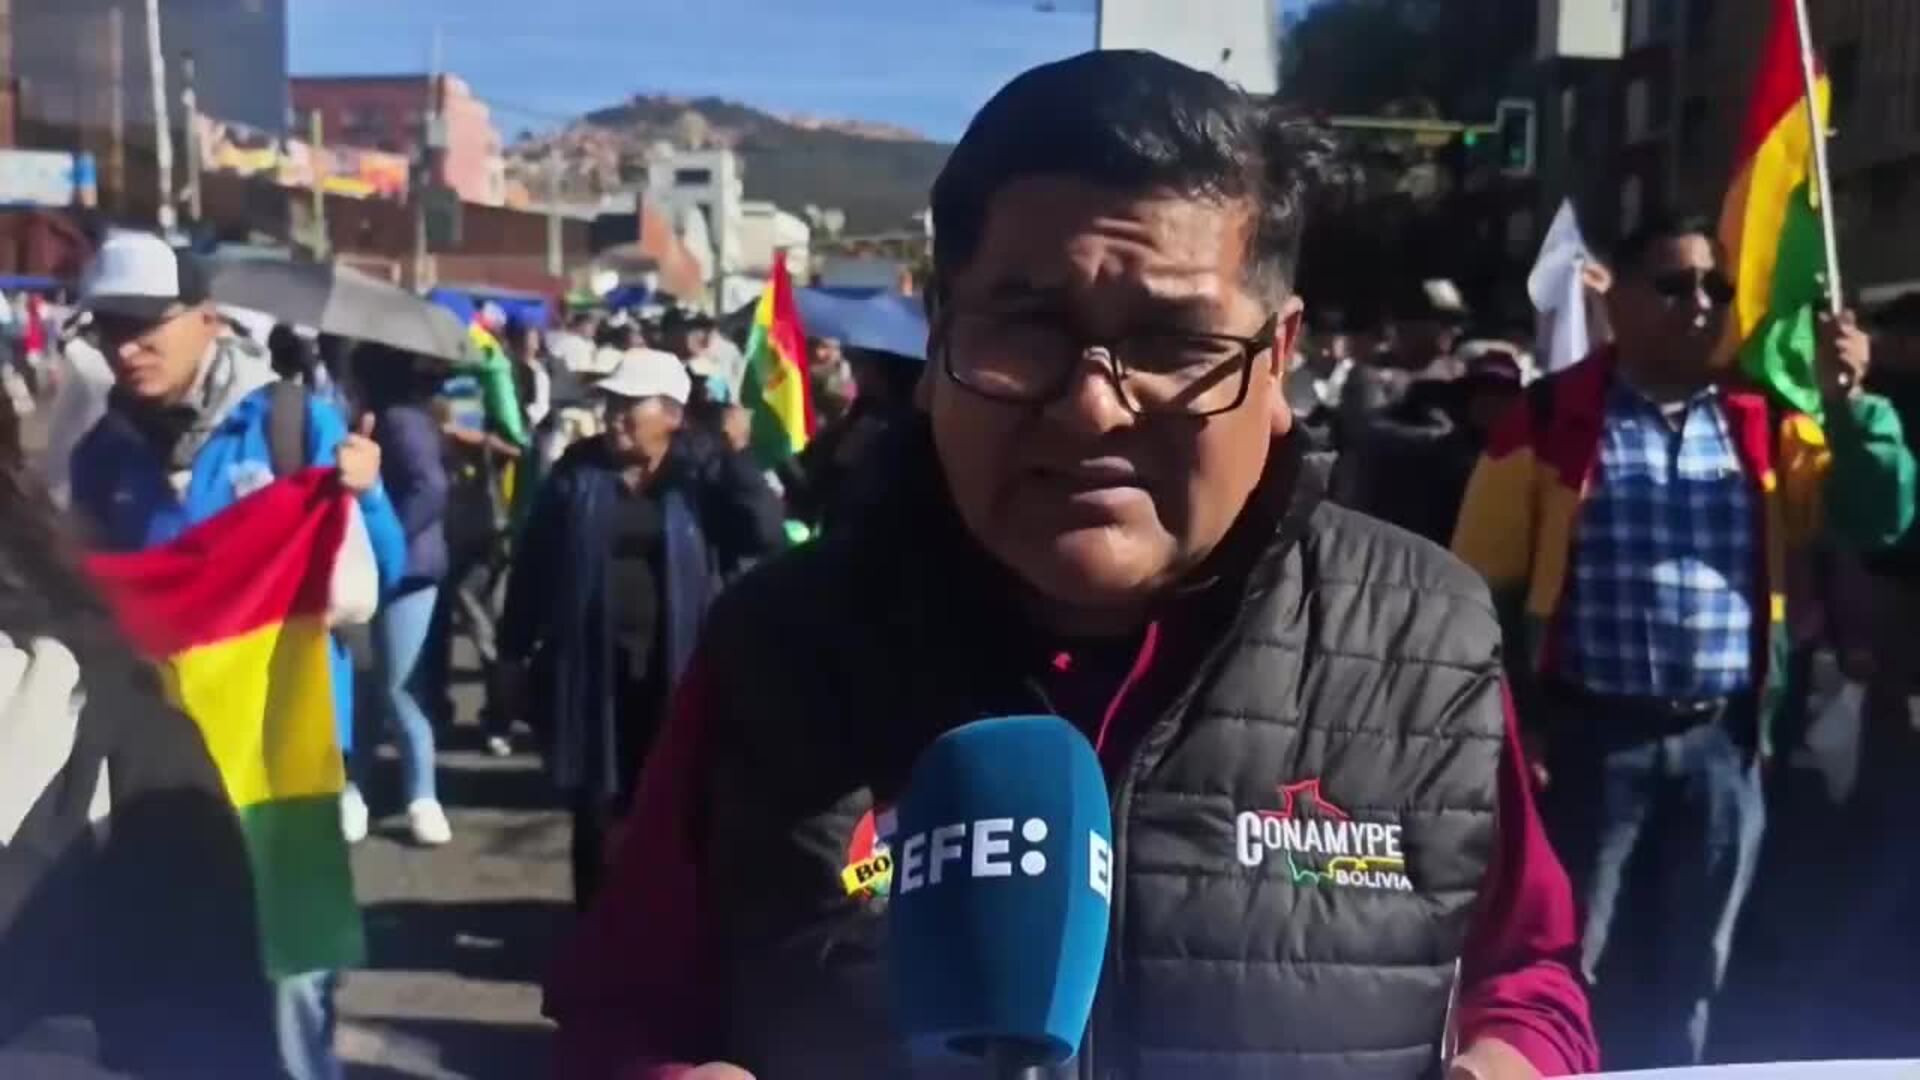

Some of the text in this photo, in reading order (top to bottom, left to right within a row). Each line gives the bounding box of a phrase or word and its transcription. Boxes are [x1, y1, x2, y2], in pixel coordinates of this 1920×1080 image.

[1089, 829, 1113, 905] E
[1236, 811, 1404, 867] CONAMYPE
[1335, 869, 1413, 892] BOLIVIA
